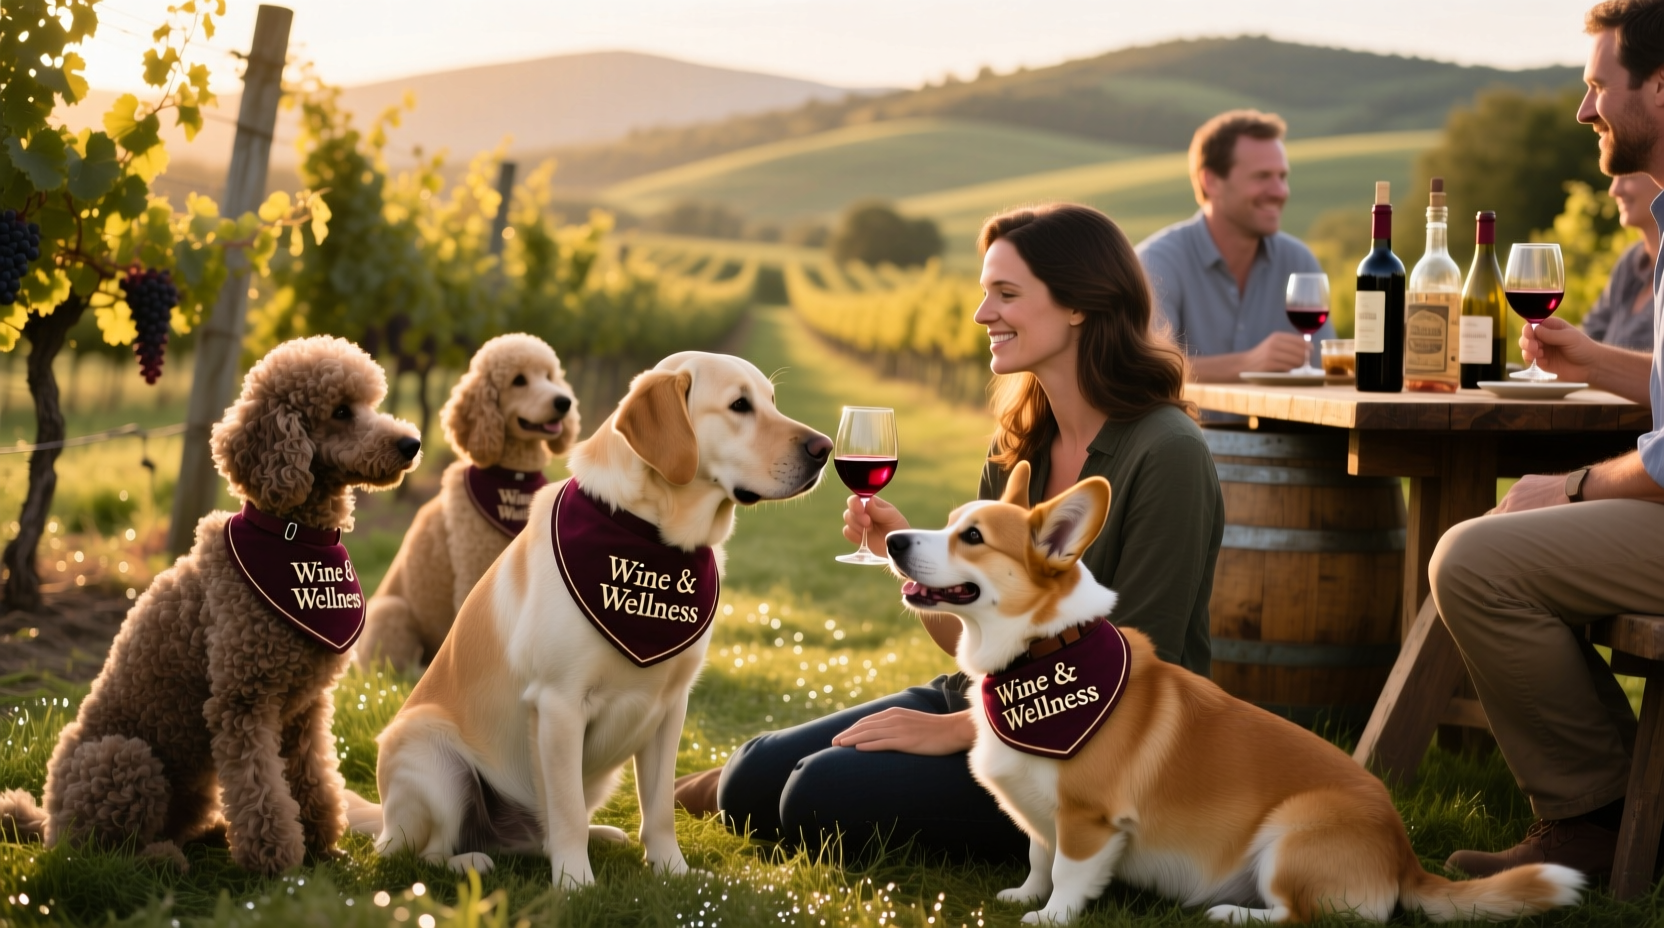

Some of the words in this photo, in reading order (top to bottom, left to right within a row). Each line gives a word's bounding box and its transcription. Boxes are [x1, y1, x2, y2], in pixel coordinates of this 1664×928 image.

[290, 561, 344, 584] Wine
[609, 555, 671, 590] Wine
[676, 568, 697, 594] &
[600, 583, 699, 624] Wellness
[994, 675, 1049, 707] Wine
[1054, 661, 1078, 685] &
[1002, 685, 1100, 731] Wellness
